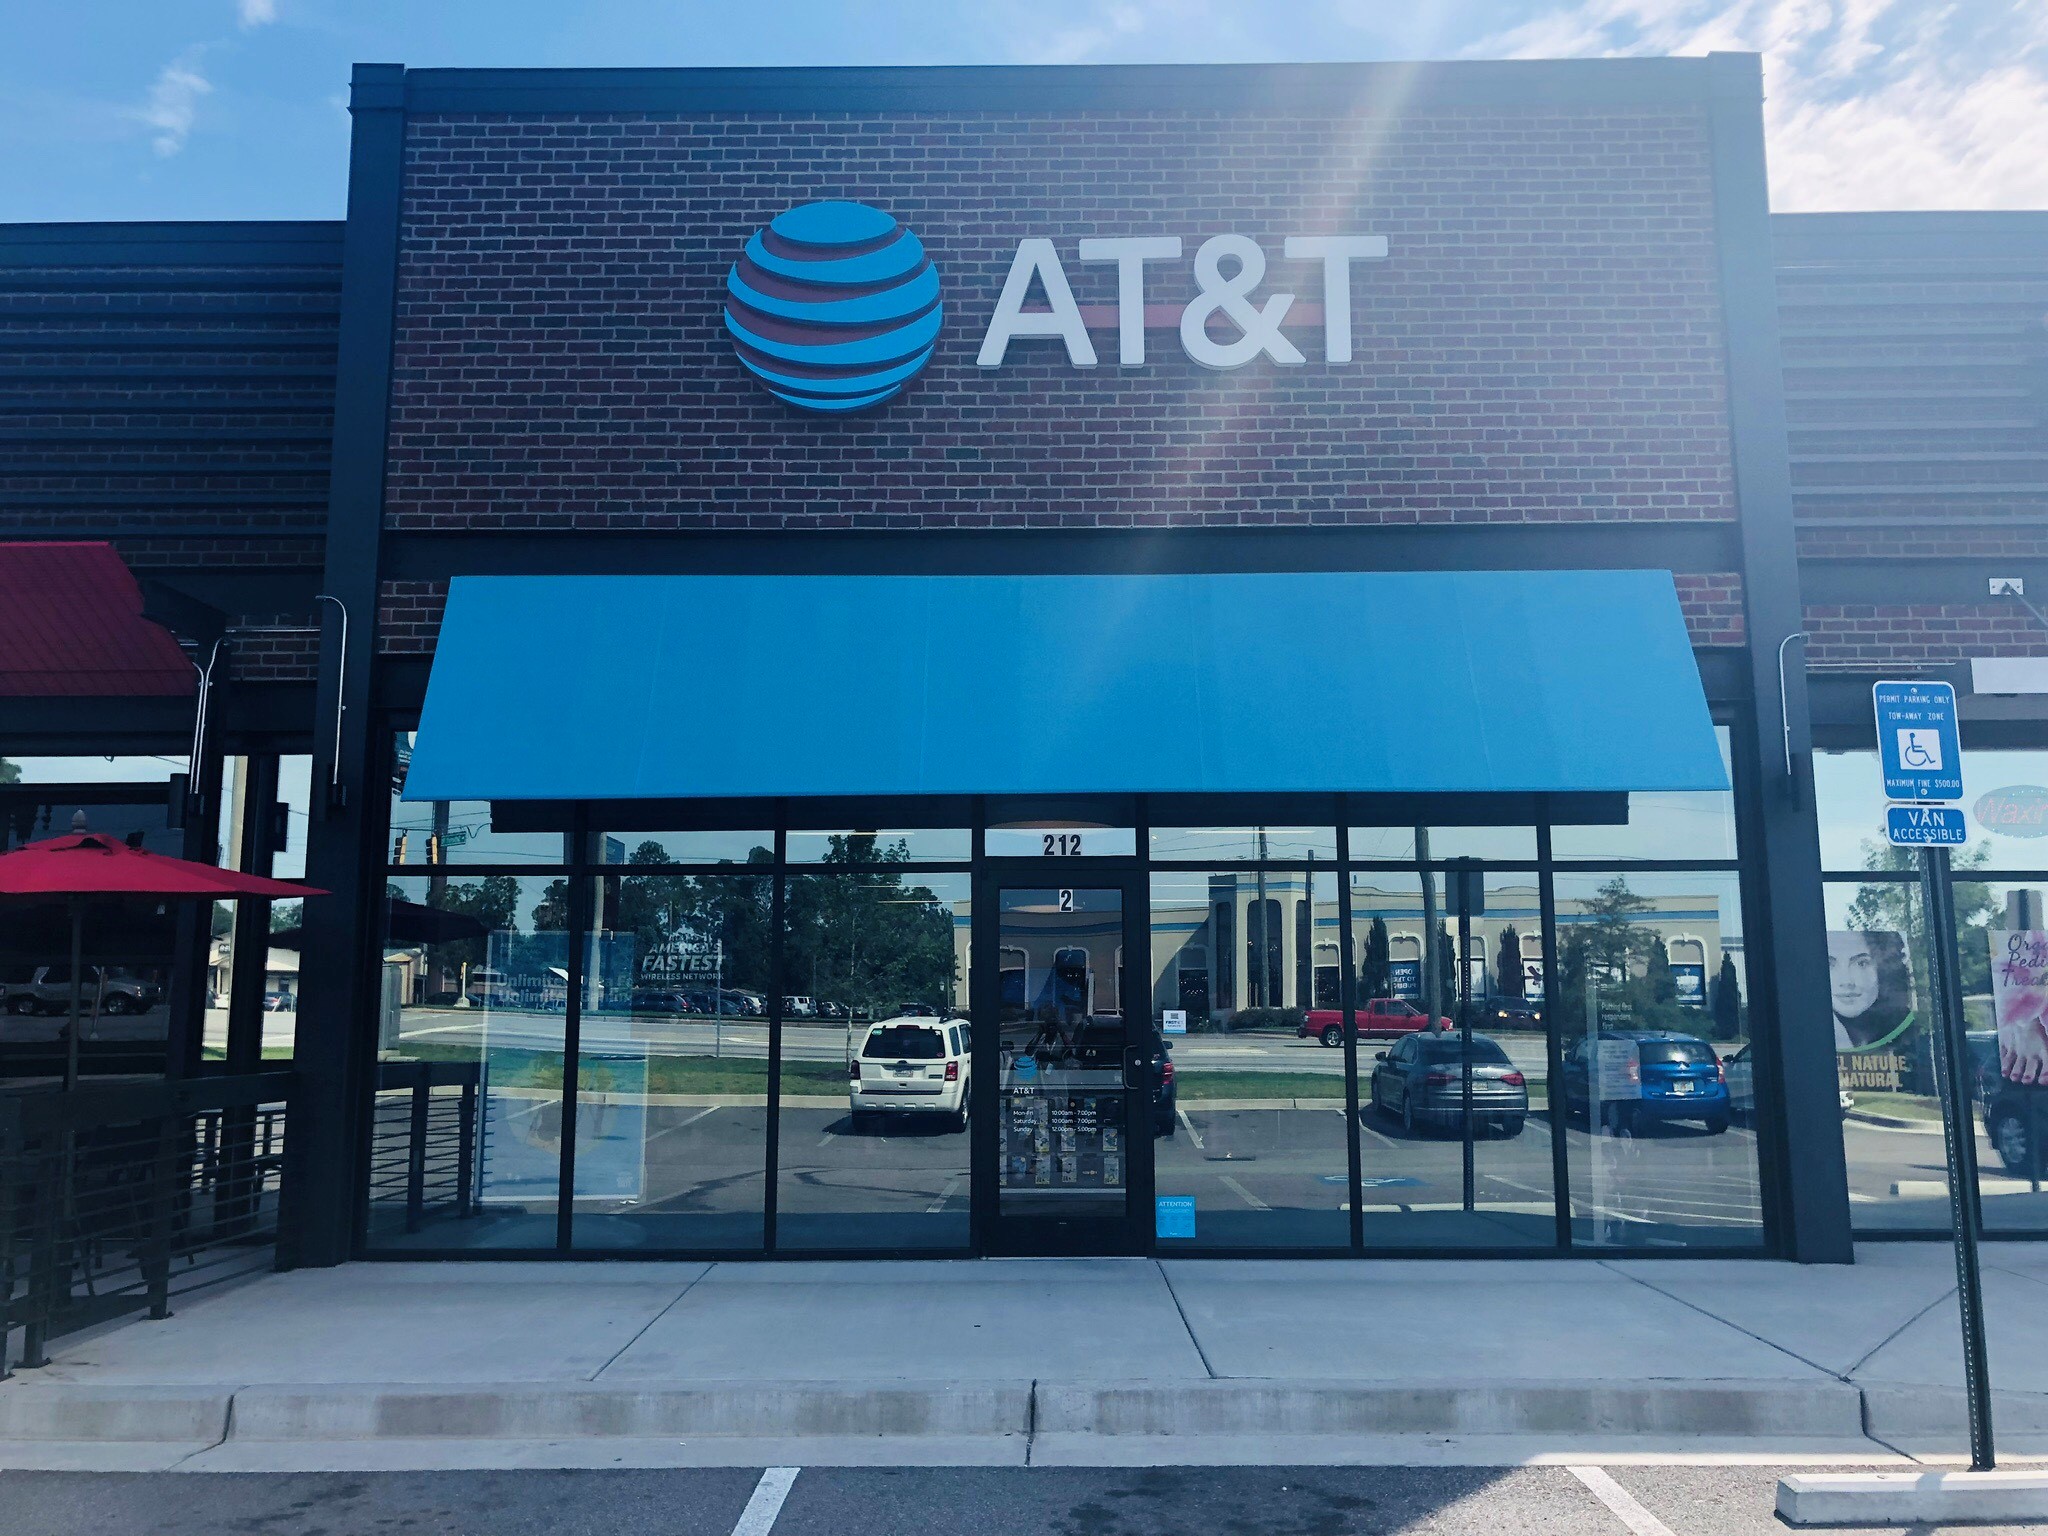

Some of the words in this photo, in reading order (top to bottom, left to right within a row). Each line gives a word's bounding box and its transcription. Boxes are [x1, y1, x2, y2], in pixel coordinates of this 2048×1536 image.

[976, 233, 1388, 370] AT&T
[1879, 695, 1900, 703] PERMIT
[1934, 696, 1949, 704] ONLY
[1888, 712, 1921, 720] TOW-AWAY
[1887, 779, 1914, 787] MAXIMUM
[1935, 780, 1960, 788] $500.00
[1907, 811, 1945, 827] VAN
[1893, 828, 1963, 841] ACCESSIBLE
[1043, 834, 1081, 855] 212
[1060, 889, 1072, 912] 2
[641, 954, 727, 972] FASTEST
[1840, 1072, 1903, 1088] NATURAL
[1013, 1087, 1035, 1095] AT&T
[1013, 1126, 1033, 1134] Sunday
